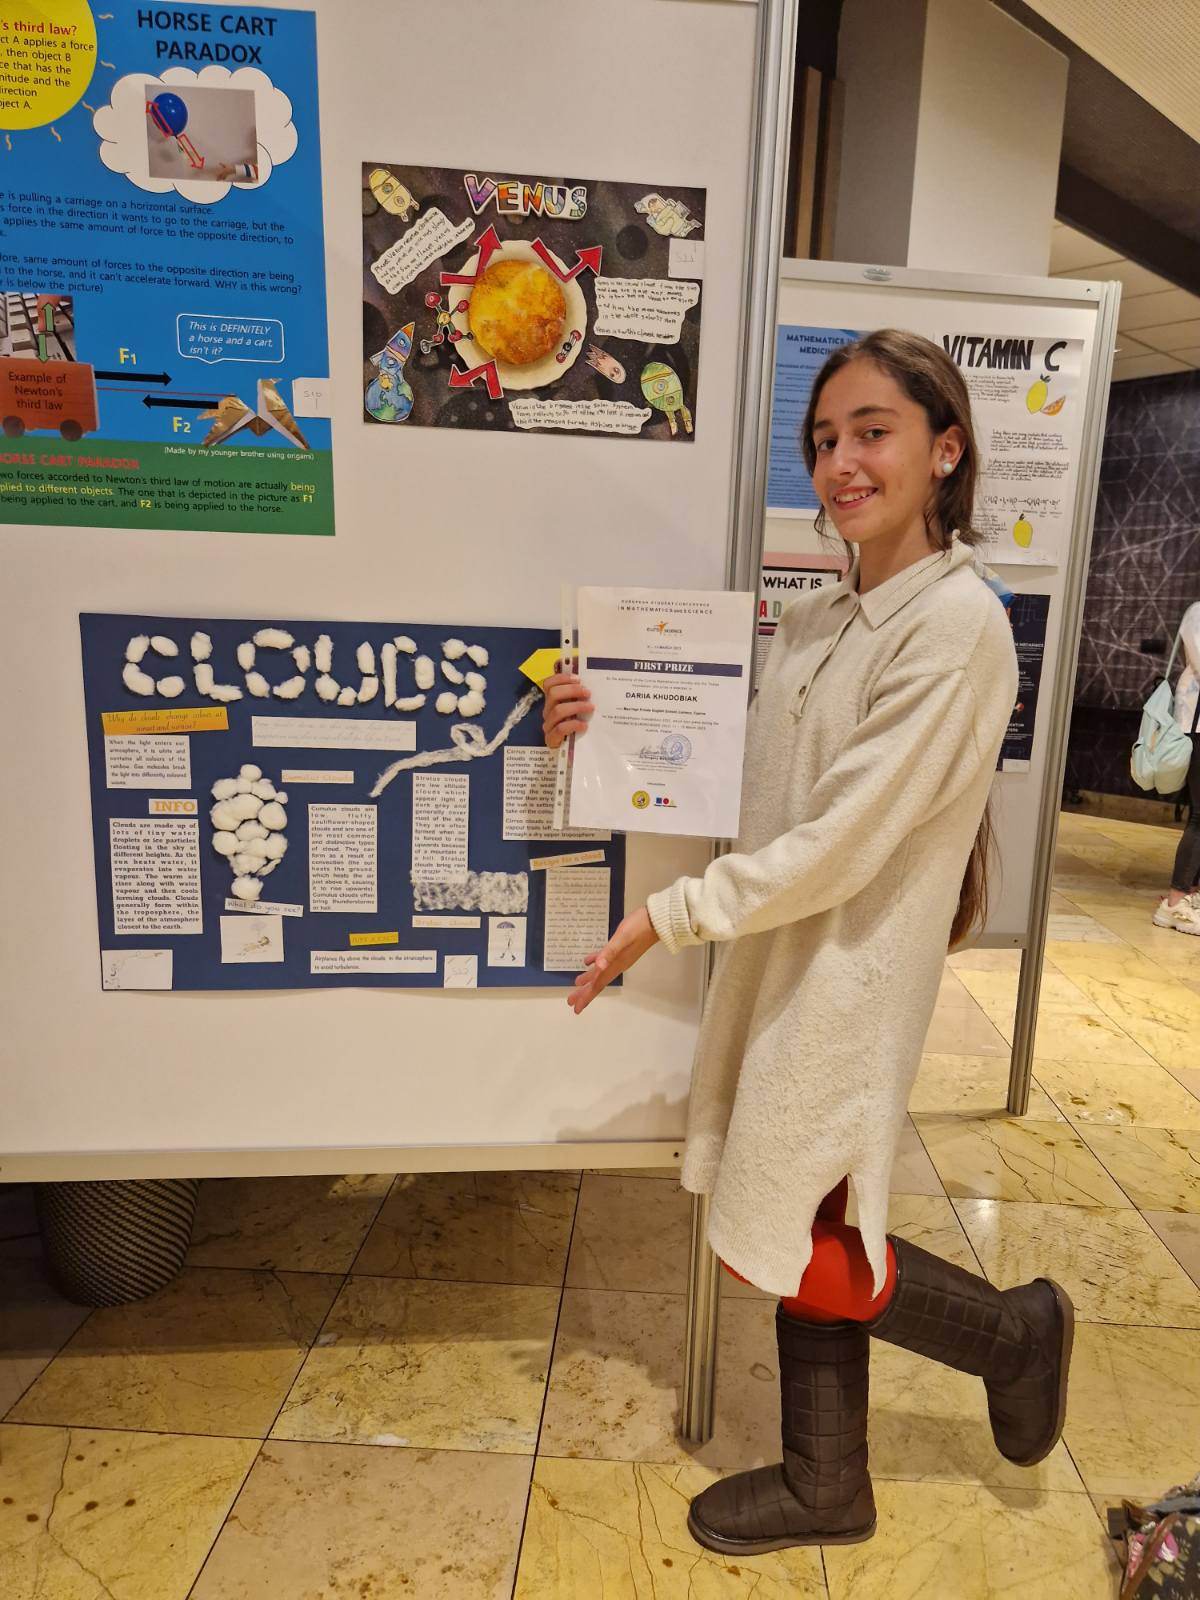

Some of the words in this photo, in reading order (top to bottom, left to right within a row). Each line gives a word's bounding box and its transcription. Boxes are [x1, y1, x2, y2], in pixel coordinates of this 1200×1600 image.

[14, 21, 45, 32] third
[48, 23, 78, 35] law?
[138, 10, 212, 31] HORSE
[220, 15, 277, 35] CART
[13, 36, 19, 44] A
[24, 38, 57, 48] applies
[70, 41, 94, 50] force
[6, 48, 28, 57] then
[31, 52, 61, 60] object
[65, 53, 71, 61] B
[156, 40, 261, 63] PARADOX
[12, 62, 32, 70] that
[464, 174, 587, 219] VENUS
[189, 321, 206, 329] This
[220, 323, 270, 334] DEFINITELY
[197, 334, 223, 343] horse
[786, 334, 844, 344] MATHEMATICS
[119, 348, 136, 363] F1
[943, 335, 1034, 370] VITAMIN
[1044, 341, 1068, 372] C
[8, 372, 52, 382] Example
[56, 373, 66, 383] of
[14, 386, 62, 396] Newton's
[16, 399, 41, 408] third
[172, 417, 190, 432] F2
[17, 471, 44, 479] forces
[47, 473, 90, 482] accorded
[105, 475, 148, 484] Newton's
[254, 481, 288, 491] actually
[290, 482, 315, 493] being
[39, 484, 78, 494] different
[188, 490, 226, 500] depicted
[258, 494, 288, 504] picture
[1, 496, 27, 505] being
[30, 496, 64, 506] applied
[140, 500, 152, 508] F2
[165, 502, 190, 512] being
[192, 503, 224, 512] applied
[763, 576, 806, 589] WHAT
[123, 628, 488, 717] CLOUDS
[155, 802, 195, 811] INFO
